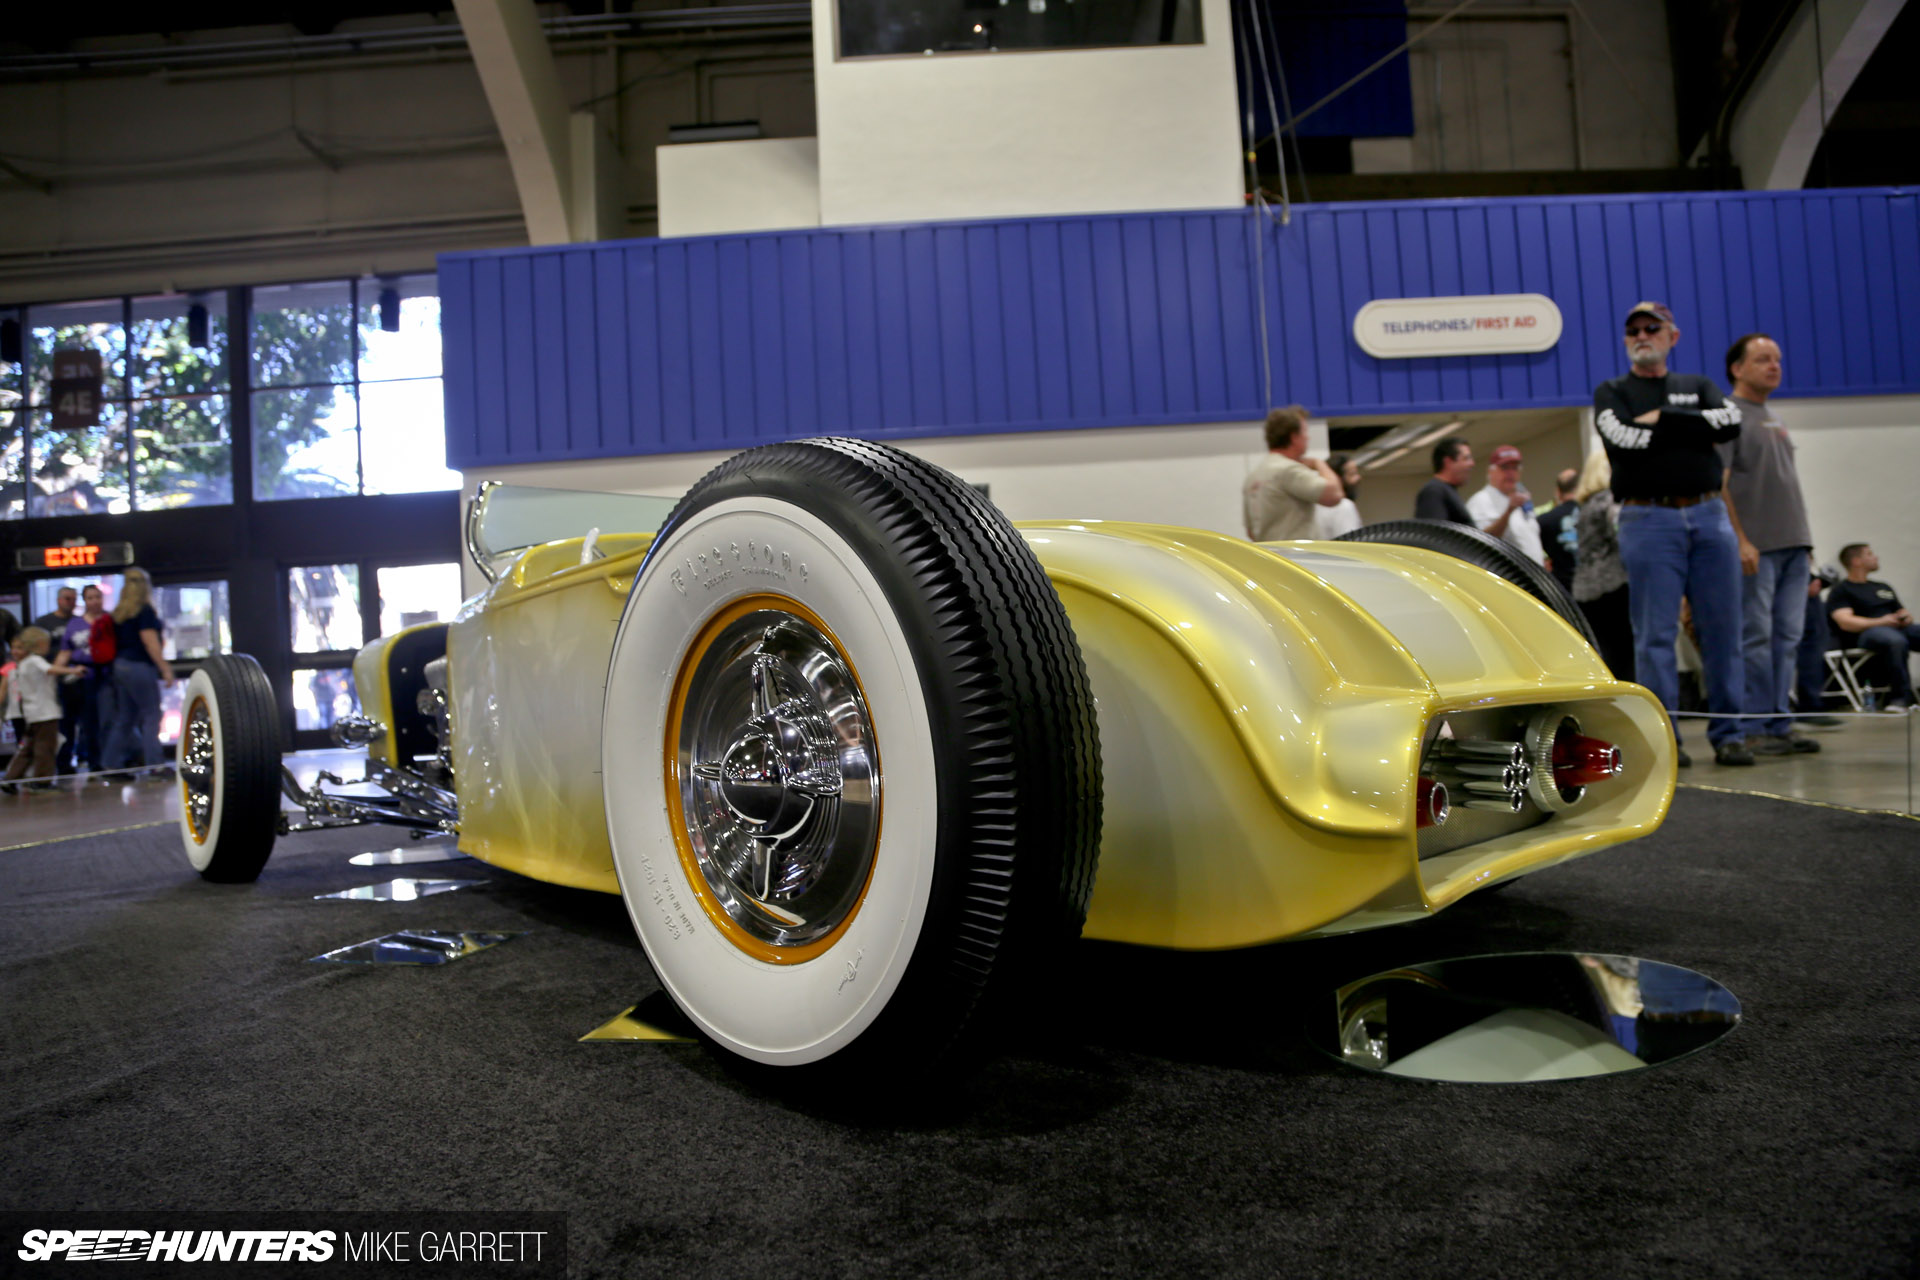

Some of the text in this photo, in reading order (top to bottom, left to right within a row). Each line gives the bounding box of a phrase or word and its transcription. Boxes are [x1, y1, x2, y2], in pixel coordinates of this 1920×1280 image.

[1513, 315, 1537, 328] AID
[58, 390, 93, 416] 4E
[1597, 408, 1653, 449] CORONA
[44, 545, 99, 567] EXIT
